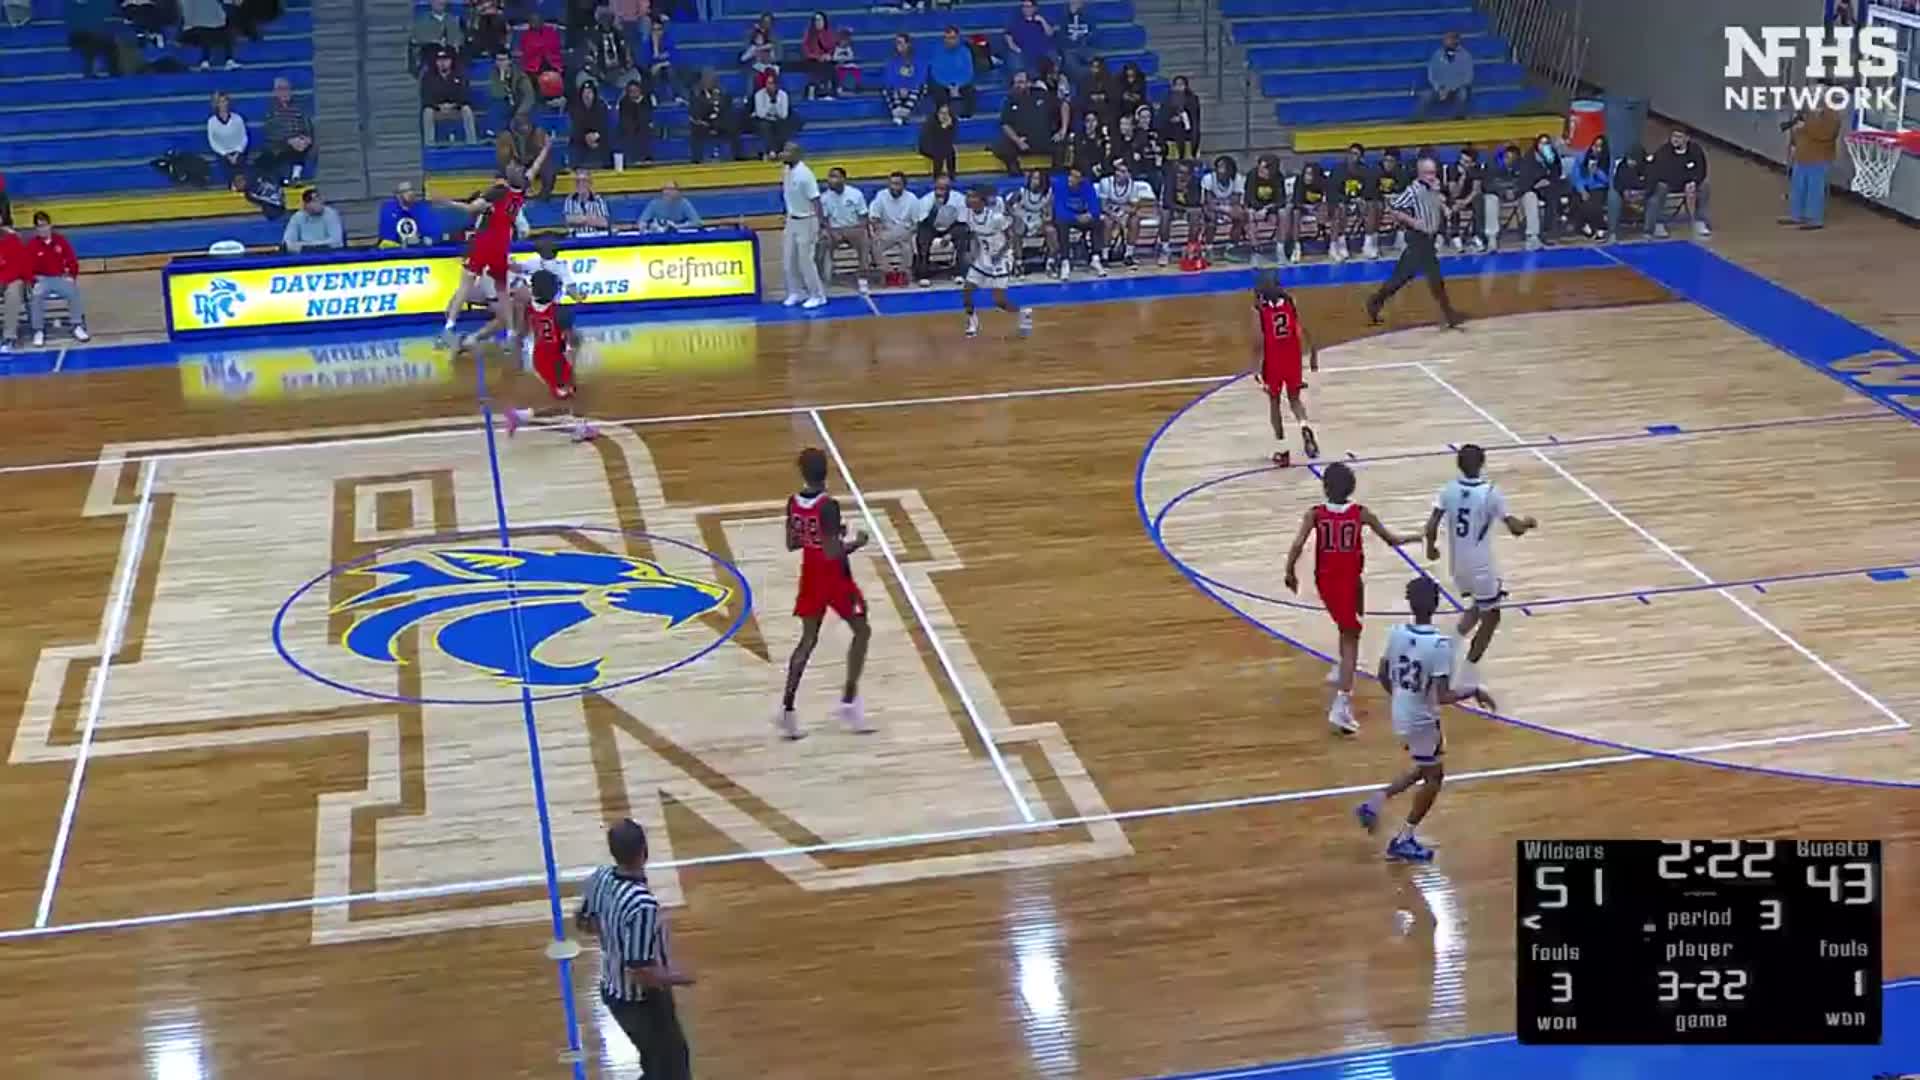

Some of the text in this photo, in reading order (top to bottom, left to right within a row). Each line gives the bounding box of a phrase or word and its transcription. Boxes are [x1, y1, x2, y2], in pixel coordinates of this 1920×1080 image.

[573, 258, 597, 273] OF
[648, 257, 744, 286] Geifman
[270, 267, 429, 294] DAVENPORT
[306, 294, 397, 317] NORTH
[1273, 312, 1289, 338] 2
[1317, 519, 1358, 552] 10
[1456, 508, 1470, 538] 5
[1397, 654, 1422, 693] 23
